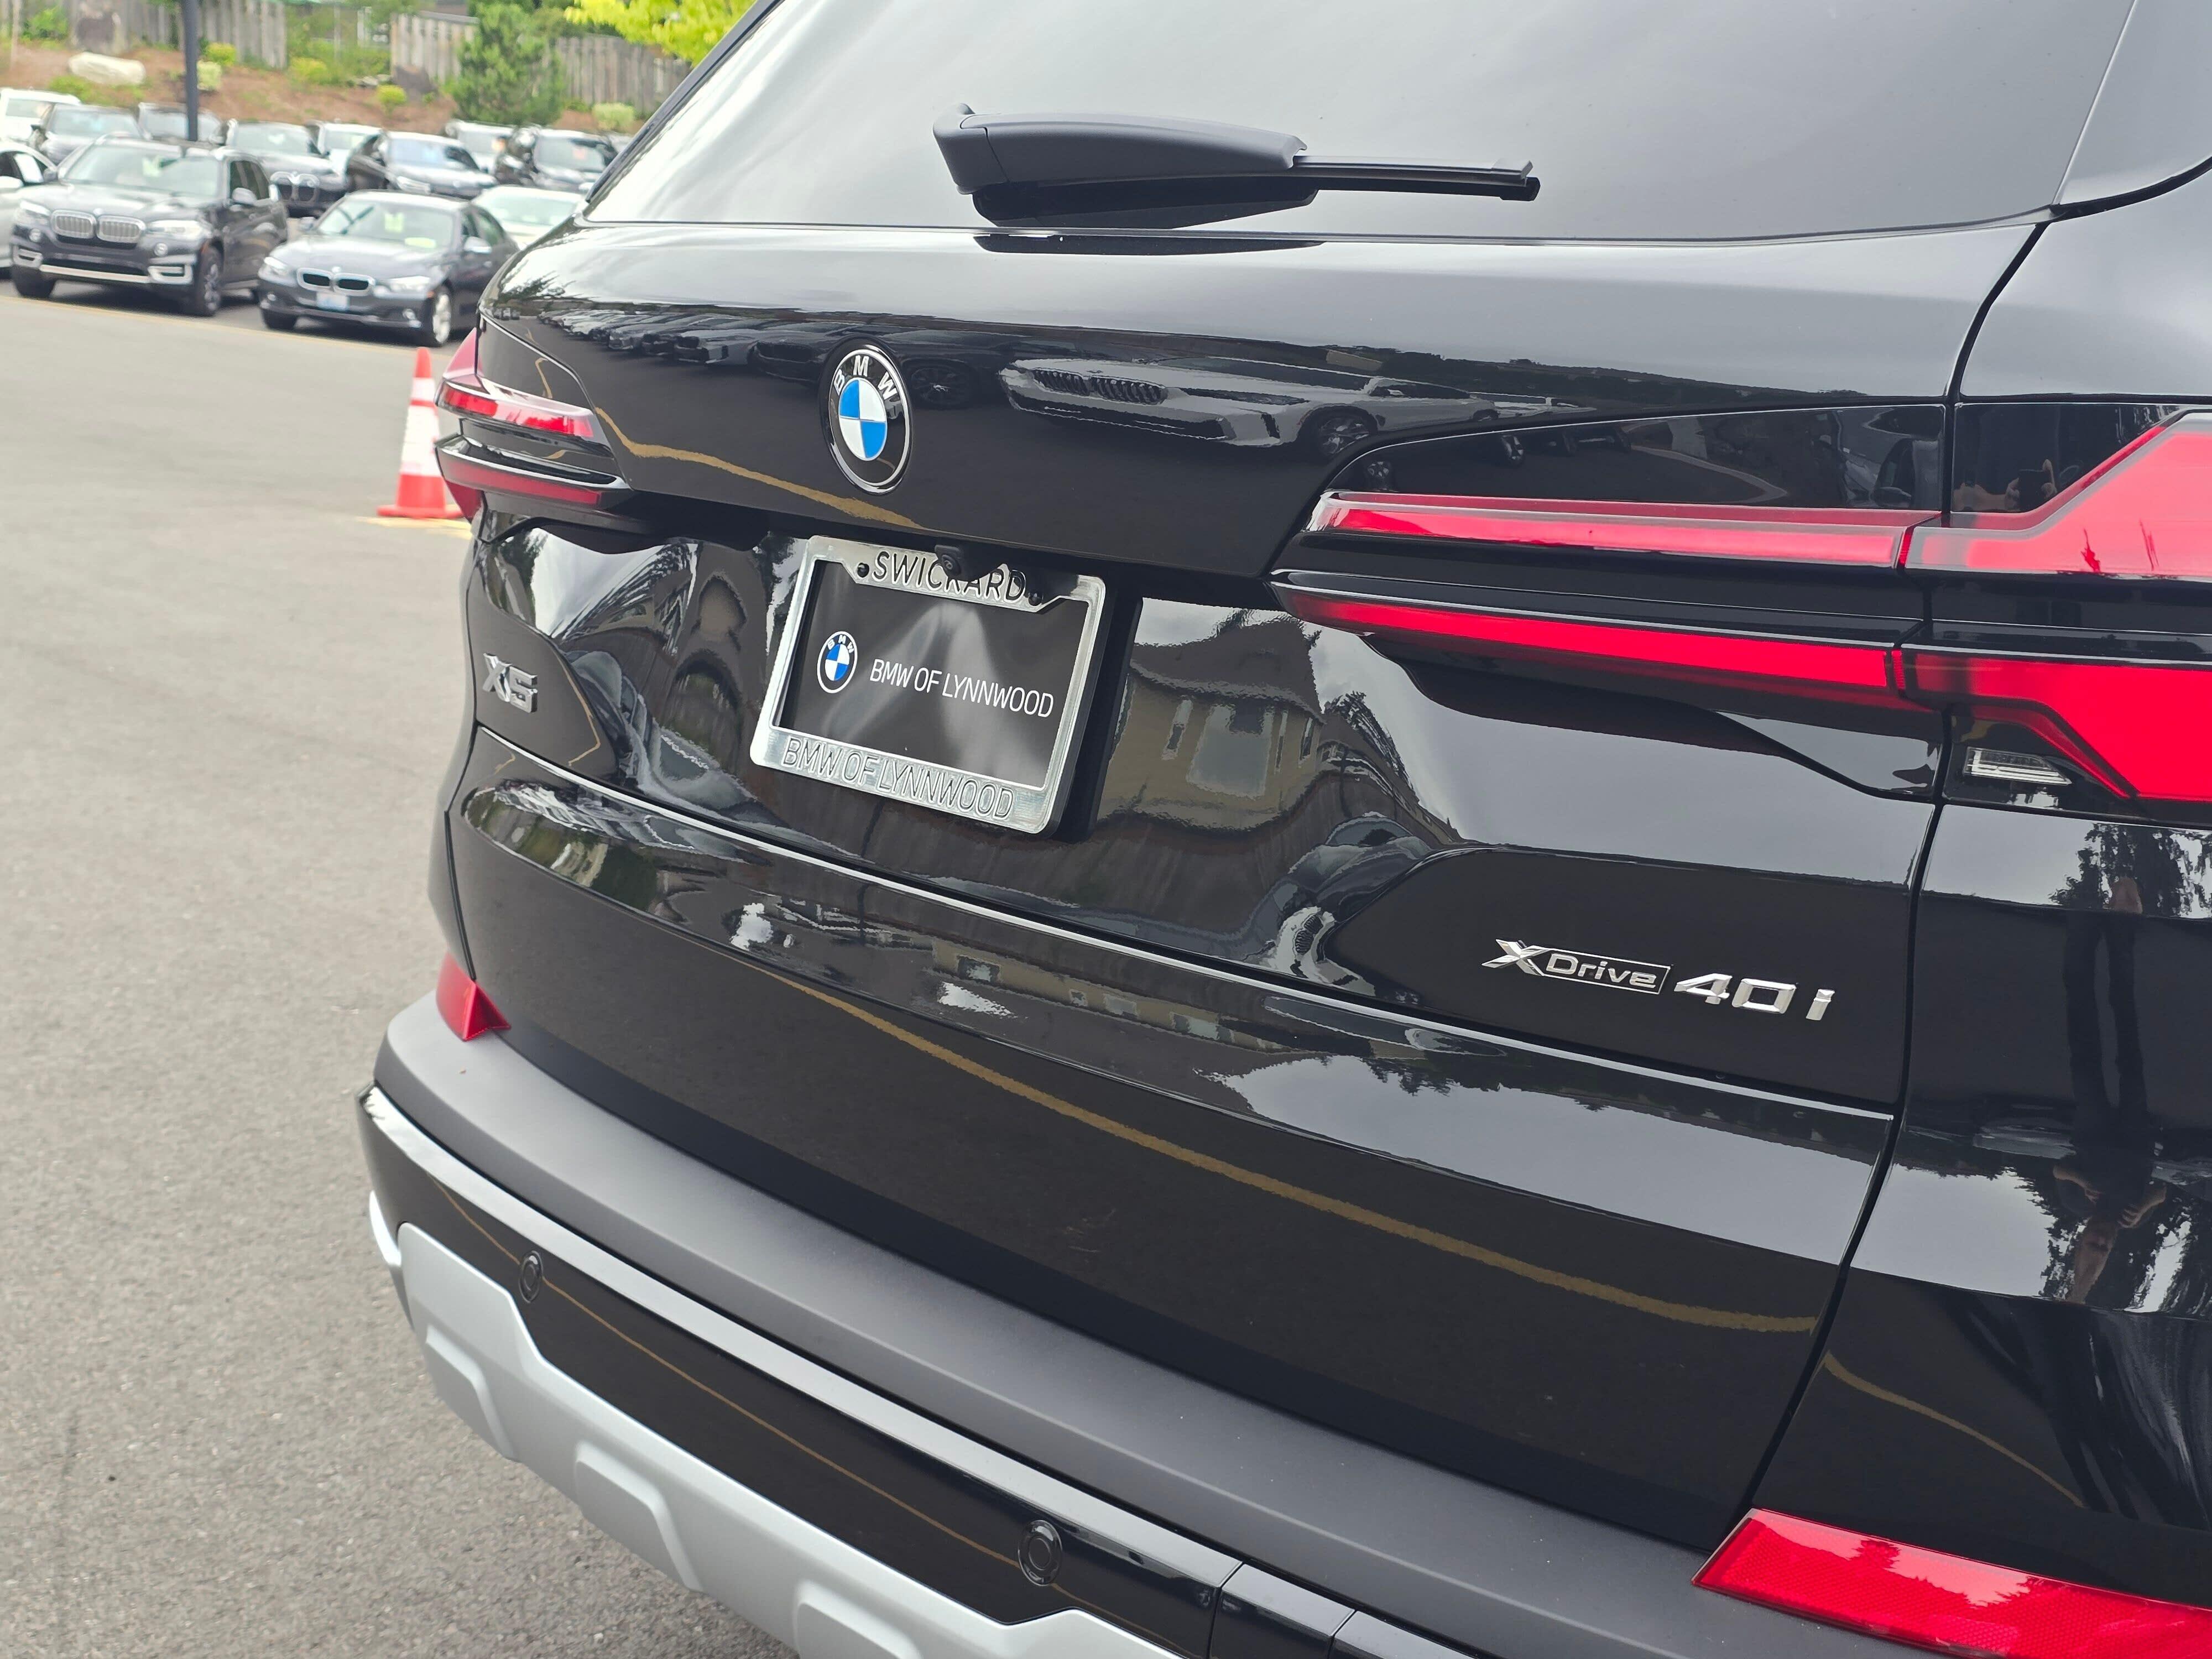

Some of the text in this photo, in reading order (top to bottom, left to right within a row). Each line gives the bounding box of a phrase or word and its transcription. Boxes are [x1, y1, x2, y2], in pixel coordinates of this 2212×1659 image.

[833, 354, 898, 400] BMW
[827, 634, 854, 653] BMW
[482, 653, 538, 713] X5
[869, 658, 1054, 718] BMW OF LYNNWOOD
[781, 735, 1014, 821] BMW OF LYNNWOOD
